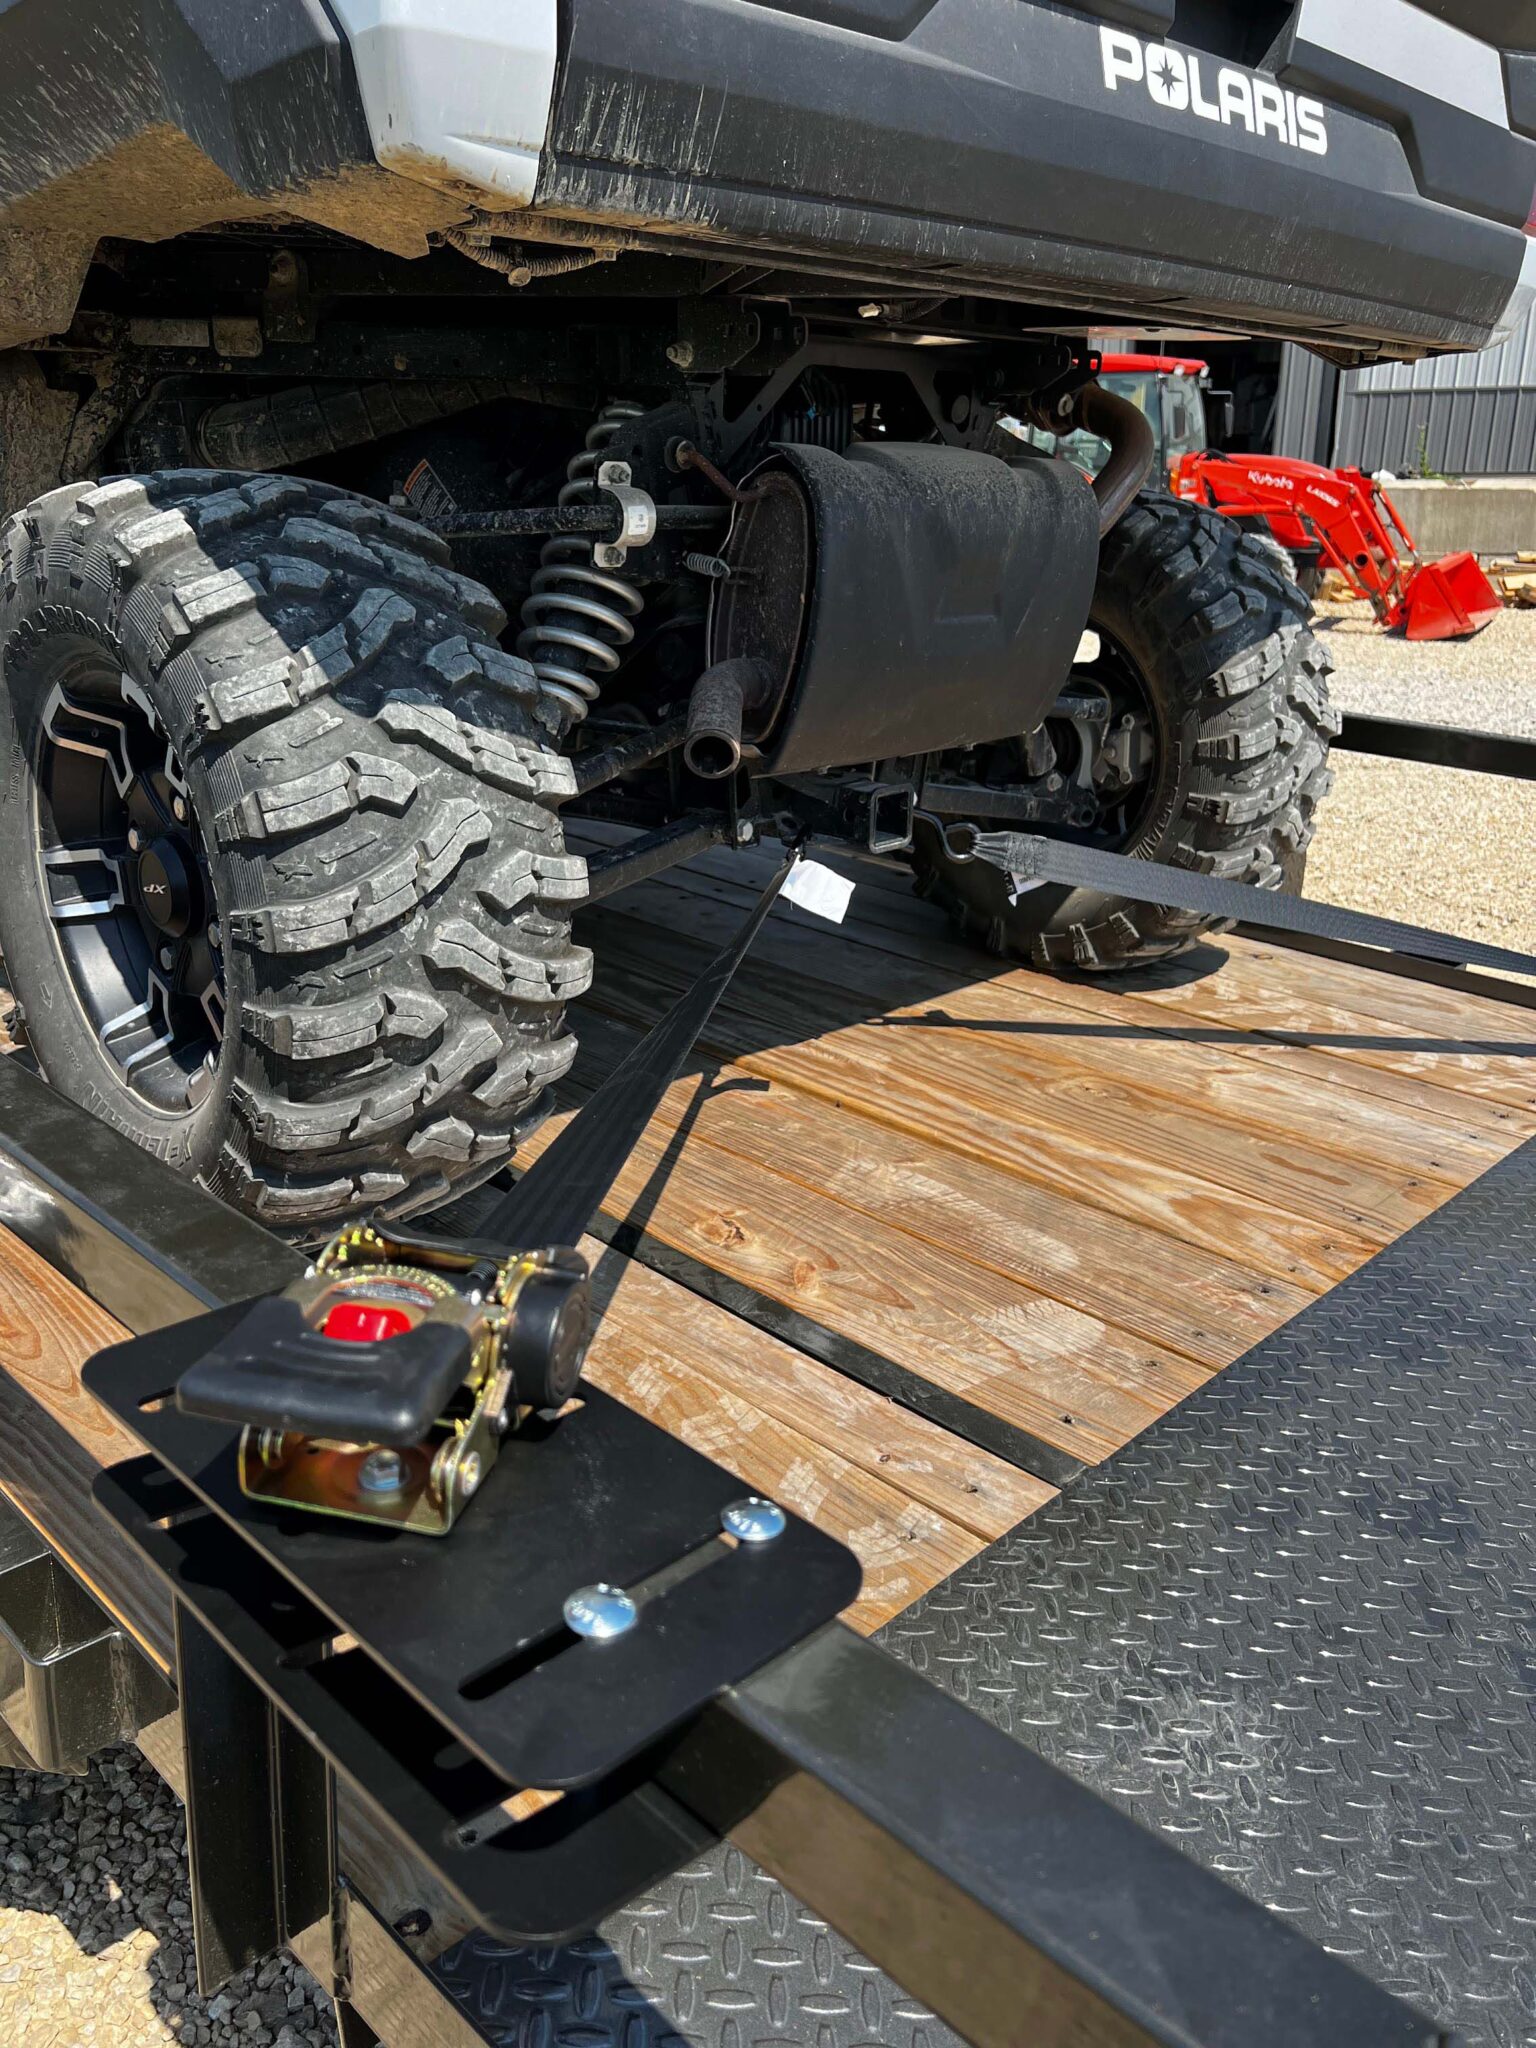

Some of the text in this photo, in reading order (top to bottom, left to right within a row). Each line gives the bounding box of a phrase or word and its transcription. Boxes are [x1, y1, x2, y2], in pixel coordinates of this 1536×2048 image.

[1100, 26, 1328, 156] POLARIS
[1248, 470, 1295, 490] Kubota
[143, 884, 166, 895] XP
